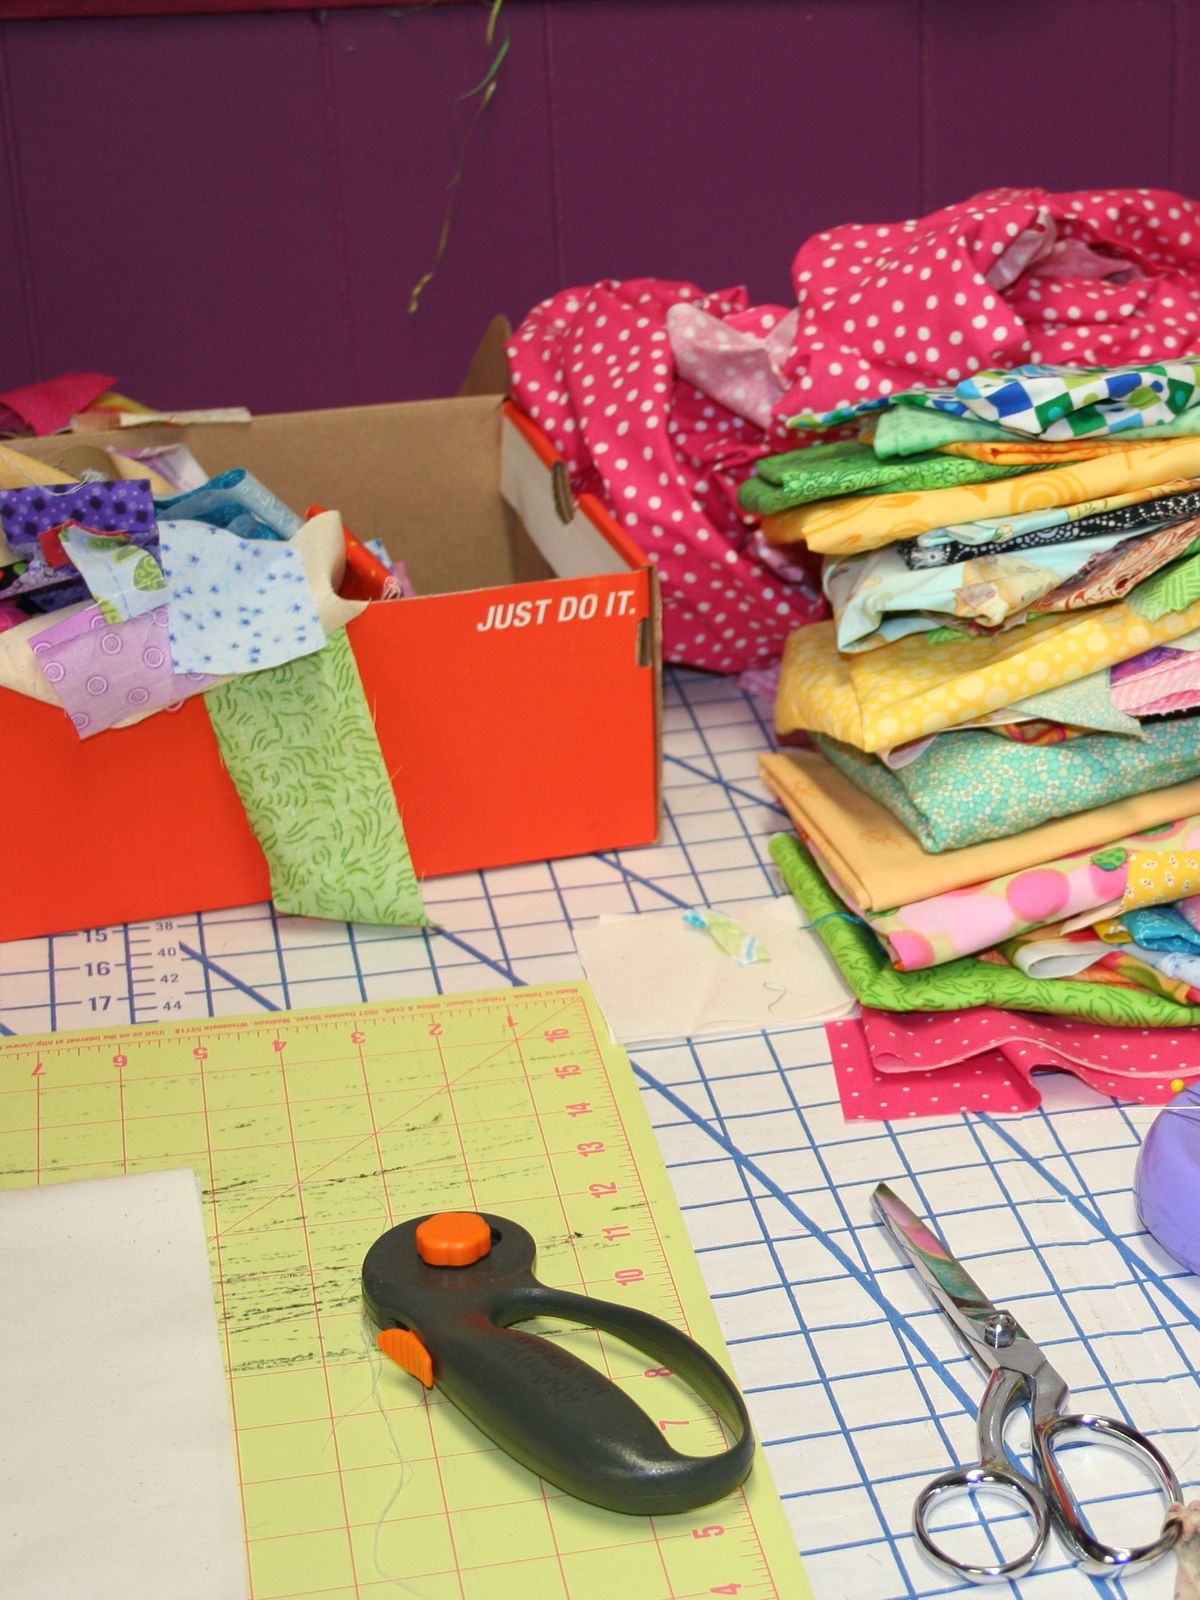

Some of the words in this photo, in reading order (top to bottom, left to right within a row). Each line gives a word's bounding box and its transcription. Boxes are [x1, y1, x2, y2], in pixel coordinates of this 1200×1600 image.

[476, 599, 552, 631] JUST
[557, 593, 598, 623] DO
[605, 590, 637, 618] IT.
[155, 920, 173, 931] 38
[83, 928, 108, 943] 15
[157, 947, 177, 957] 40
[84, 961, 111, 977] 16
[160, 973, 179, 983] 42
[88, 995, 112, 1011] 17
[163, 1000, 182, 1011] 44
[507, 1015, 518, 1028] 1
[429, 1023, 443, 1036] 2
[544, 1028, 570, 1042] 16
[351, 1031, 366, 1044] 3
[192, 1046, 209, 1060] 5
[272, 1040, 287, 1052] 4
[113, 1054, 128, 1067] 6
[31, 1062, 47, 1076] 7
[555, 1064, 581, 1079] 15
[565, 1102, 593, 1117] 14
[577, 1141, 605, 1157] 13
[589, 1182, 617, 1198] 12
[601, 1225, 630, 1241] 11
[615, 1268, 645, 1286] 10
[644, 1366, 674, 1379] 8
[659, 1419, 690, 1431] 7
[692, 1524, 725, 1539] 5
[710, 1582, 742, 1595] 4
